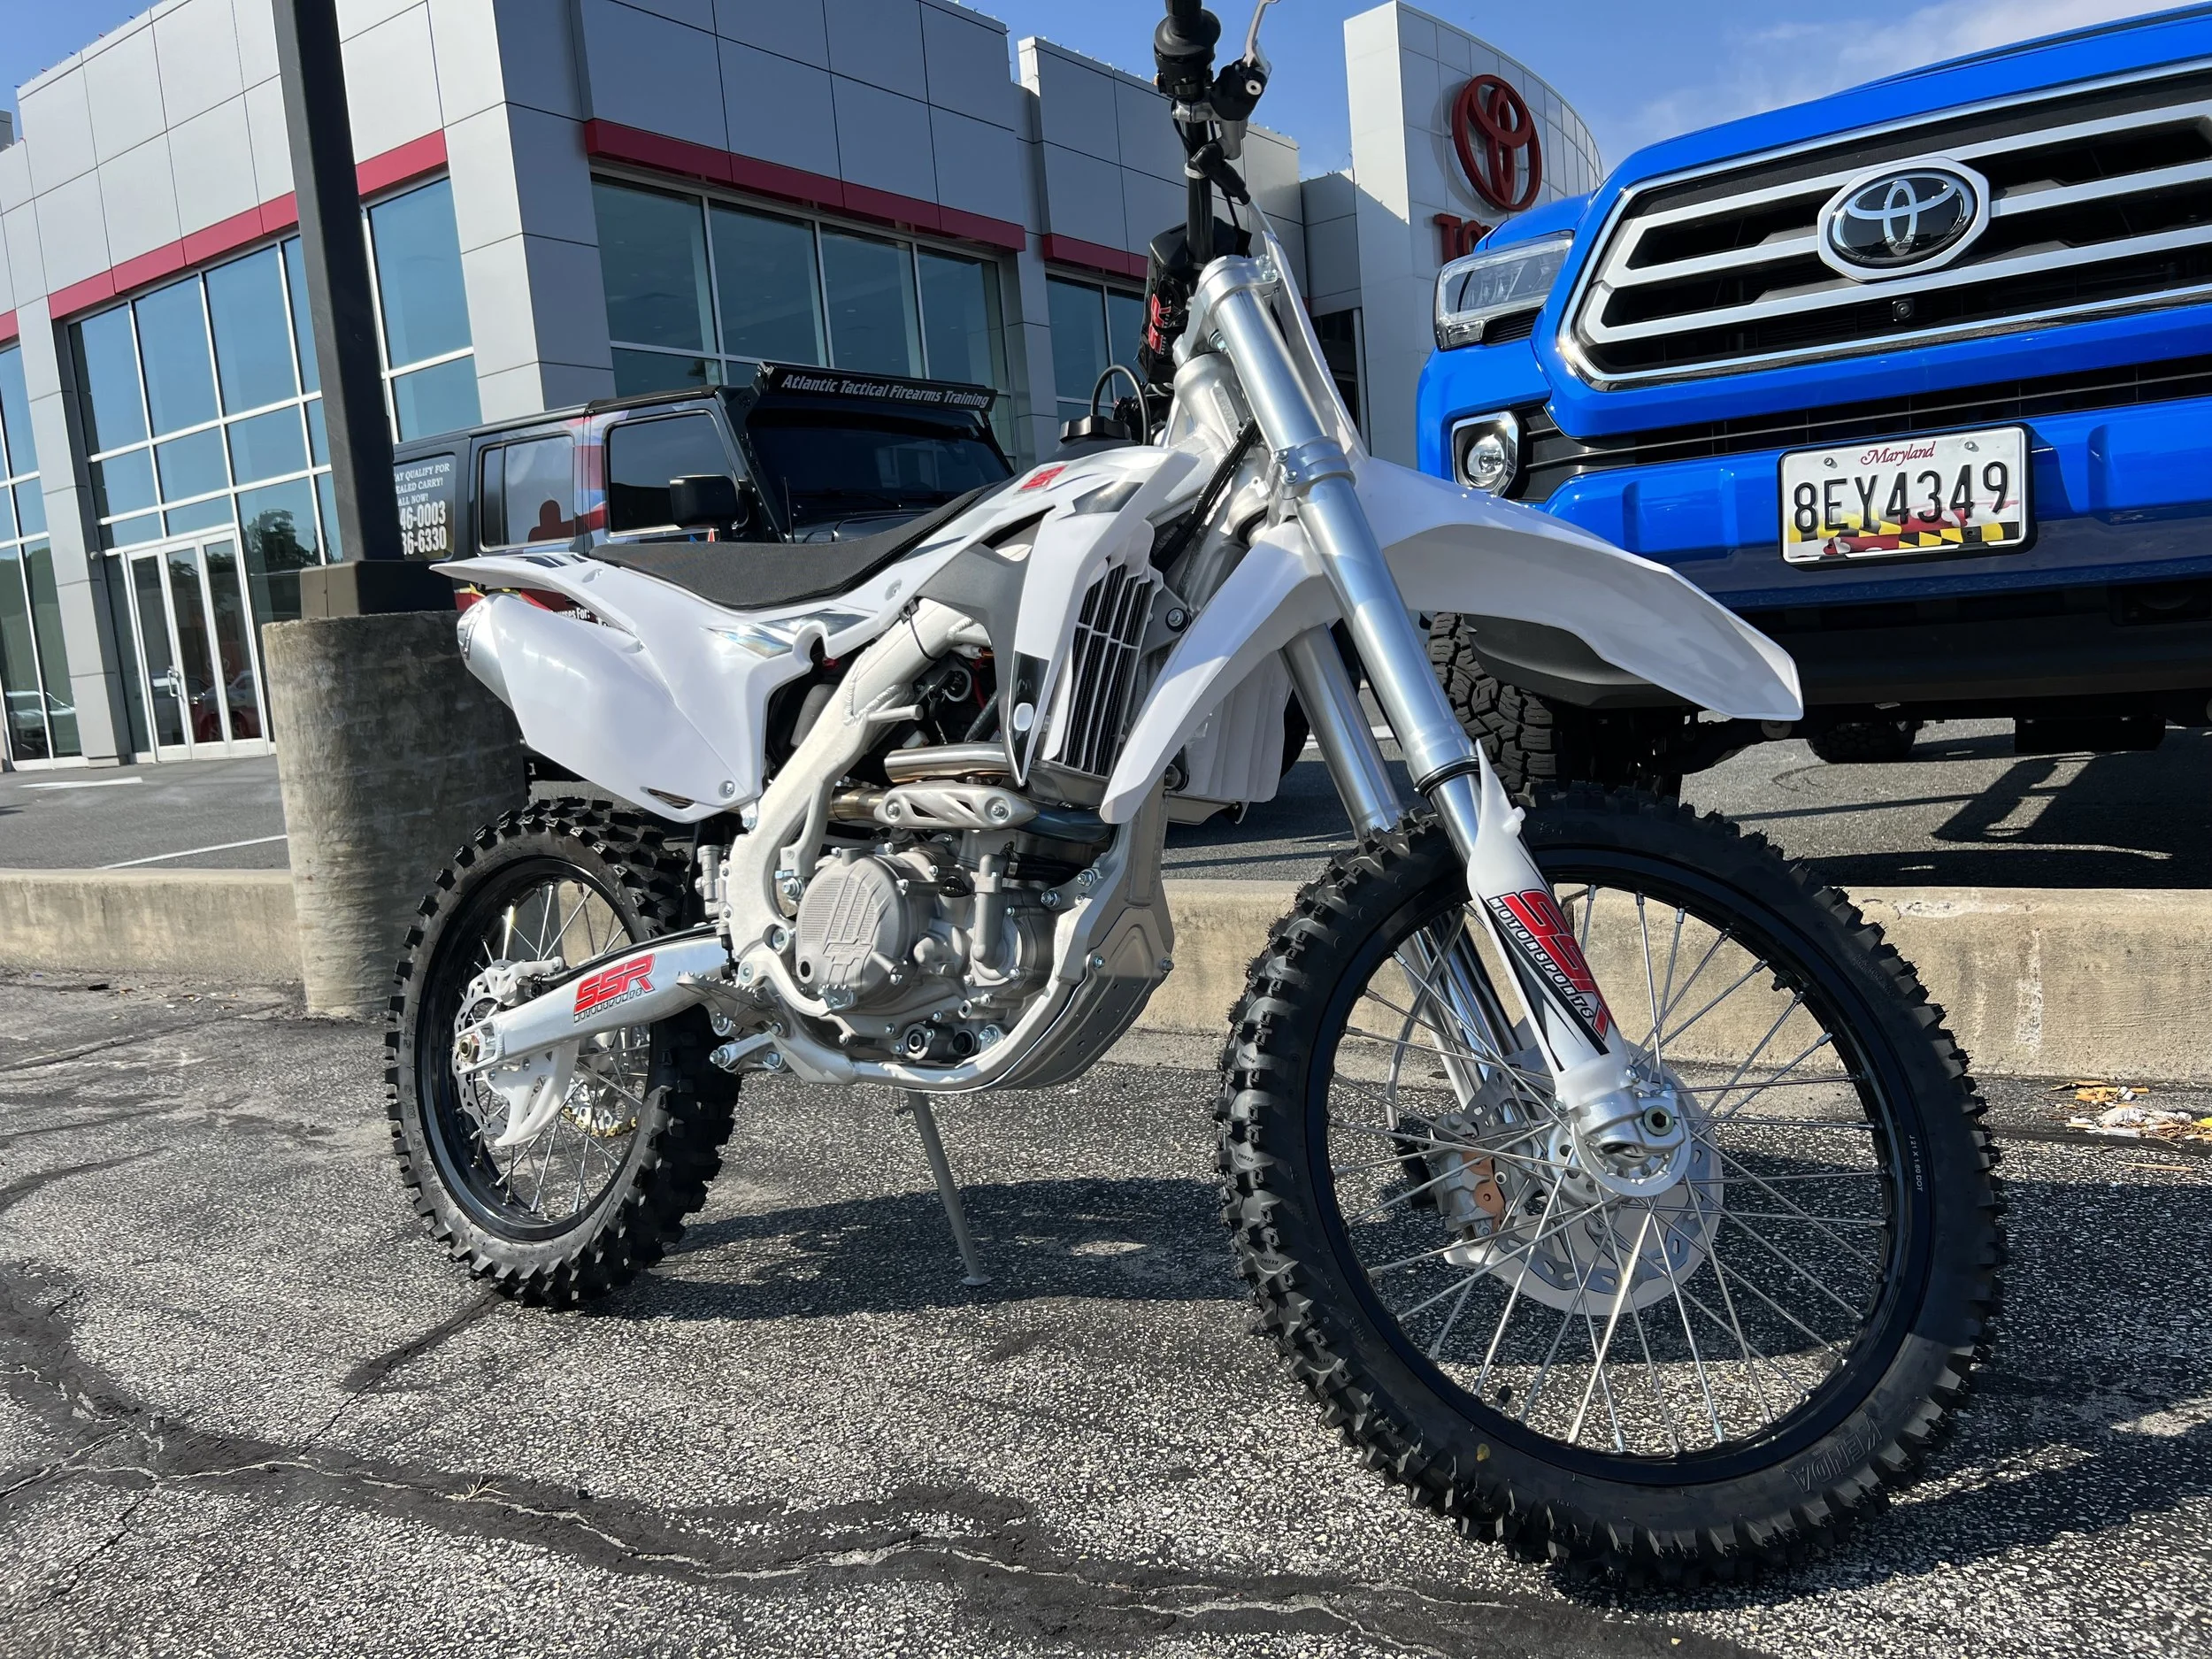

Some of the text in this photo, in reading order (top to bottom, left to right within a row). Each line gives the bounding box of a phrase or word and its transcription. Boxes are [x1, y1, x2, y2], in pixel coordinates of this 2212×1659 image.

[781, 374, 989, 408] Atlantic Tactical Firearms Training
[1860, 441, 1937, 466] Maryland
[395, 463, 450, 482] AY QUALIFY FOR
[411, 493, 429, 504] NOW!
[1793, 461, 2008, 534] 8EY4349
[576, 607, 591, 619] For:
[1487, 896, 1594, 1019] MOTORSPORTS
[573, 953, 656, 1016] SSR
[1791, 1417, 1883, 1494] KENDA
